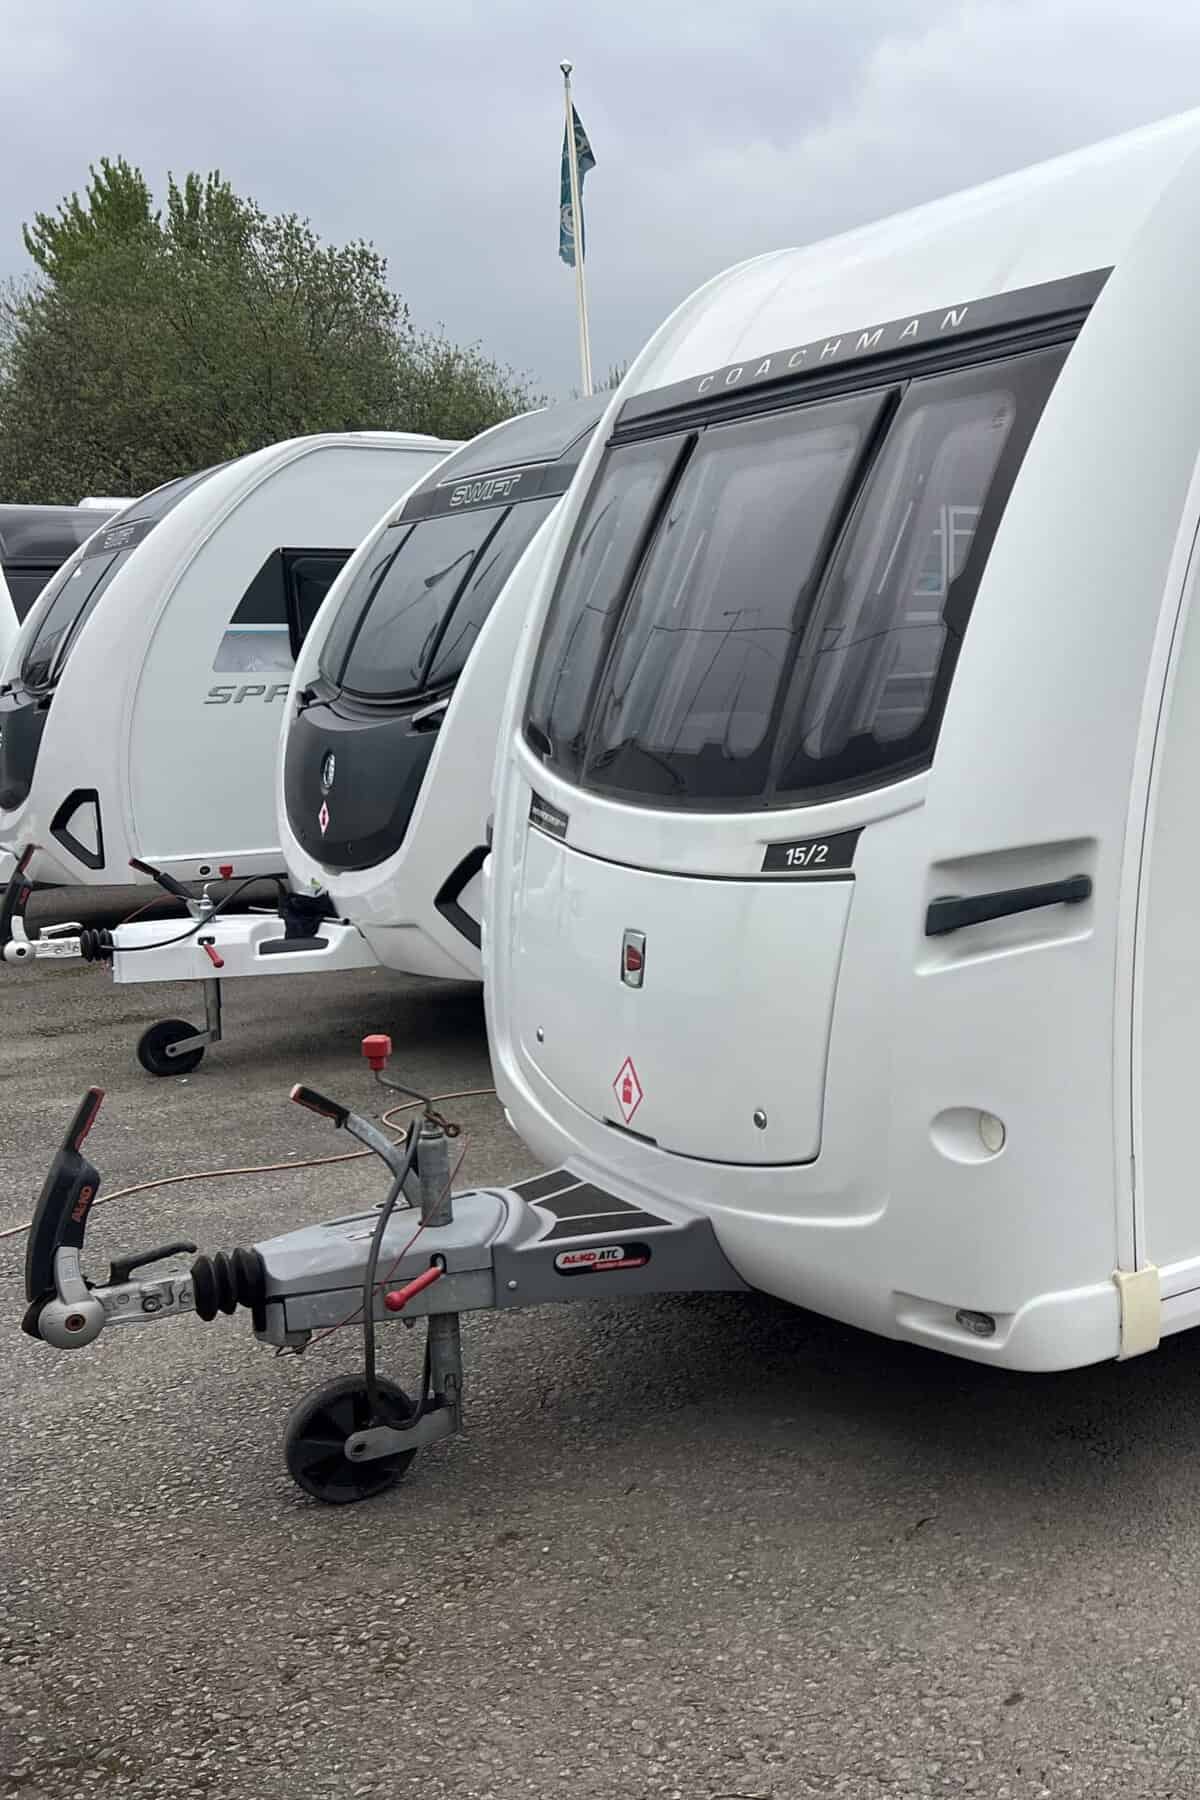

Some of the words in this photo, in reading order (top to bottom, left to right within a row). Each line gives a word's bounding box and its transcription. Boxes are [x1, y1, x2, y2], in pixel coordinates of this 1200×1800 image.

[697, 307, 968, 393] COACHMAN
[450, 473, 522, 507] SWIFT
[785, 844, 829, 866] 15/2
[598, 1248, 619, 1261] ATC
